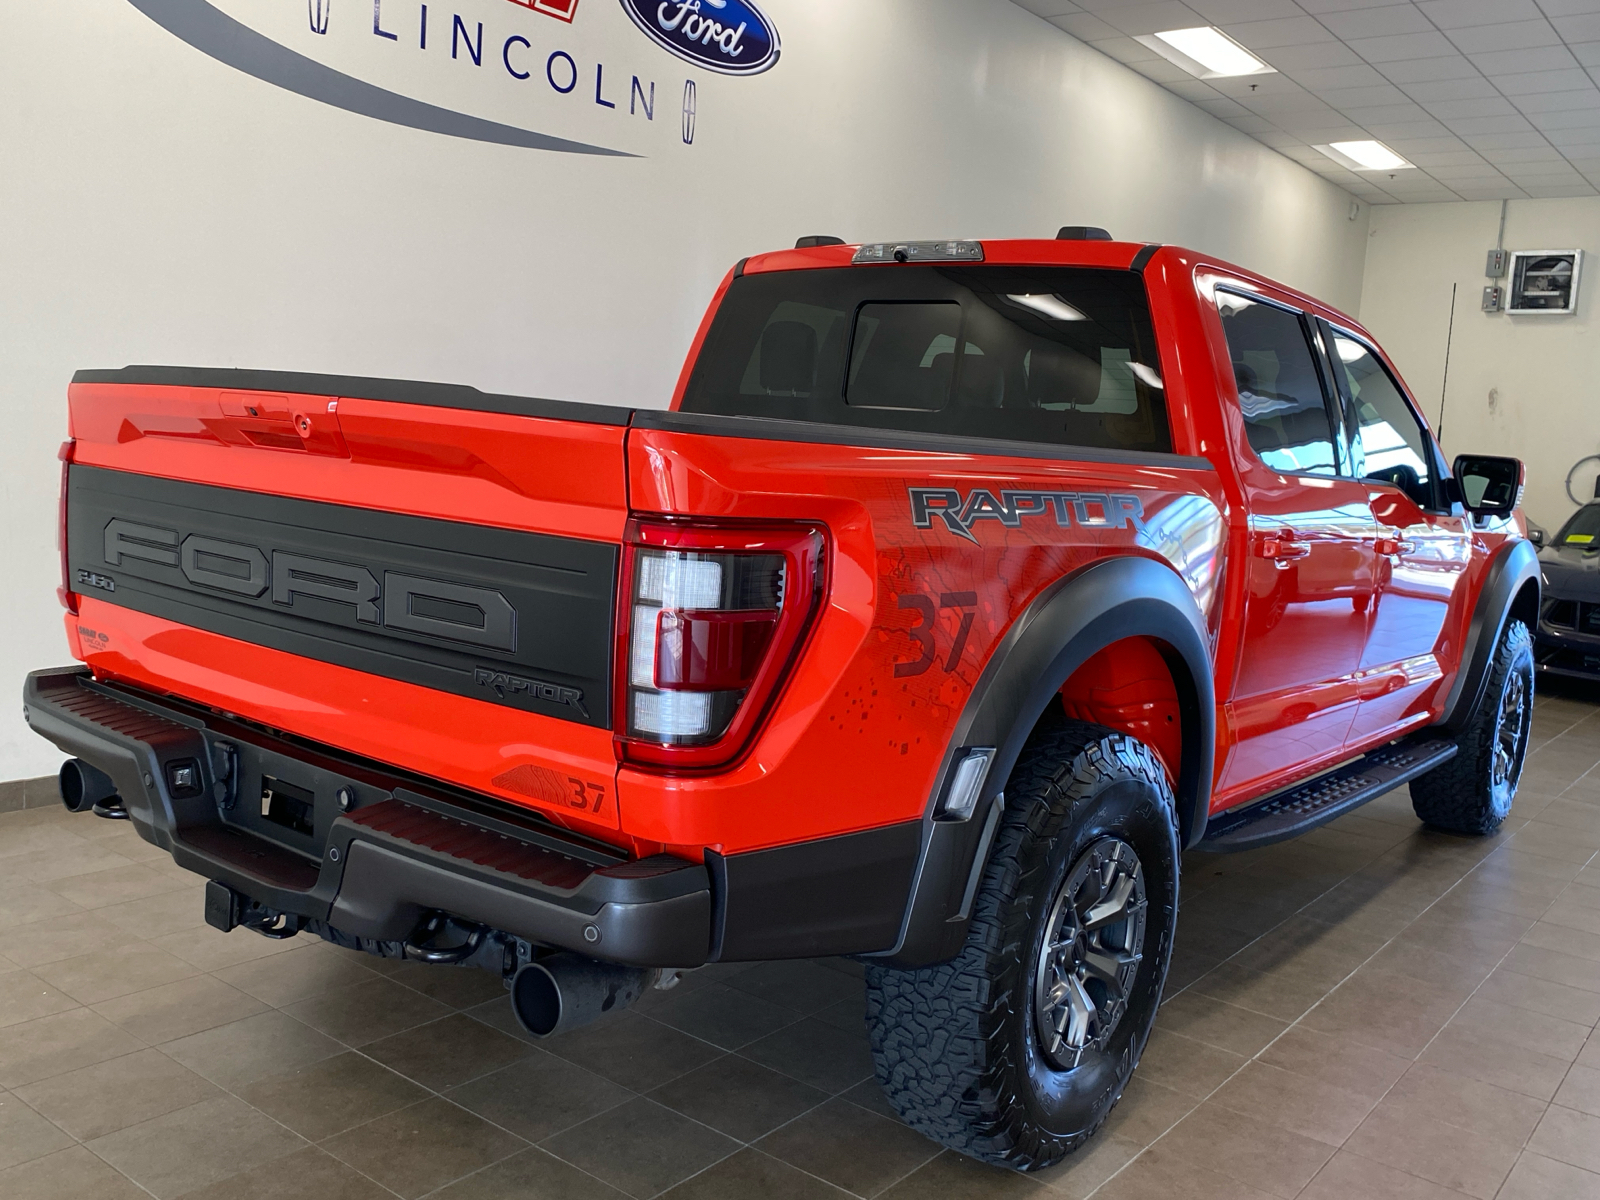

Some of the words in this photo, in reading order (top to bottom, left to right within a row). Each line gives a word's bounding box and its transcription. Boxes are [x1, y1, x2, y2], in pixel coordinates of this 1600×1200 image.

[657, 0, 747, 57] Ford
[373, 0, 655, 121] LINCOLN
[908, 487, 1157, 548] RAPTOR
[103, 517, 517, 655] FORD
[893, 591, 978, 678] 37
[474, 666, 590, 718] RAPTOR
[567, 777, 605, 813] 37
